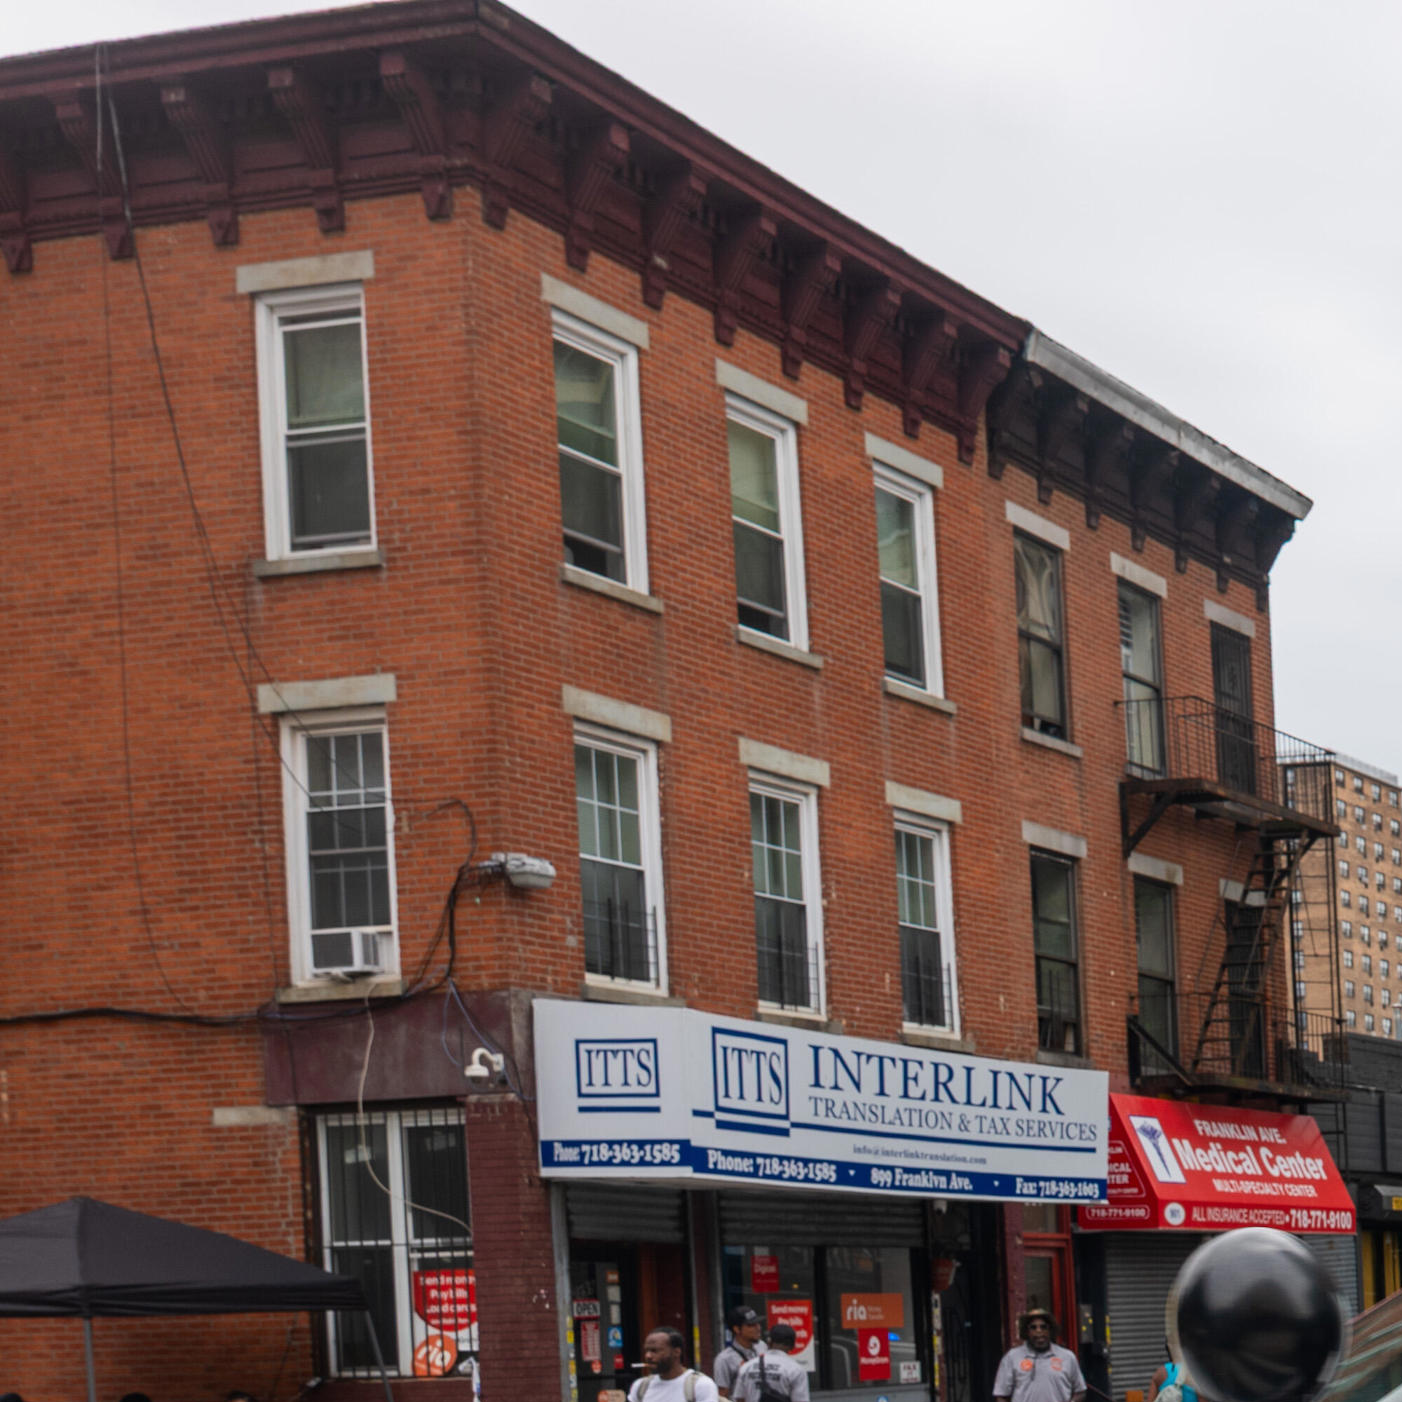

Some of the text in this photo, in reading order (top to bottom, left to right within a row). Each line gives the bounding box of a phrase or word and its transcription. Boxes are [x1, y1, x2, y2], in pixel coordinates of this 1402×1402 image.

[584, 1048, 653, 1088] ITTS
[720, 1045, 783, 1106] ITTS
[807, 1044, 1065, 1116] INTERLINK
[808, 1095, 1097, 1142] TRANSLATION & TAX SERVICES
[1193, 1119, 1287, 1144] FRANKLIN AVE.
[581, 1142, 681, 1165] 718-363-1585
[707, 1149, 837, 1183] Phone: 718-363-1585
[852, 1143, 988, 1166] info@interlinktranslation.com
[1171, 1138, 1328, 1180] Medical Center
[870, 1167, 893, 1186] 899
[949, 1172, 974, 1192] Ave.
[1212, 1178, 1318, 1197] MULTI-SPECIALTY CENTER
[1192, 1205, 1207, 1221] ALL
[1207, 1206, 1248, 1224] INSURANCE
[1289, 1209, 1353, 1229] 718-771-9100
[576, 1302, 598, 1315] OPEN
[846, 1298, 867, 1321] ria
